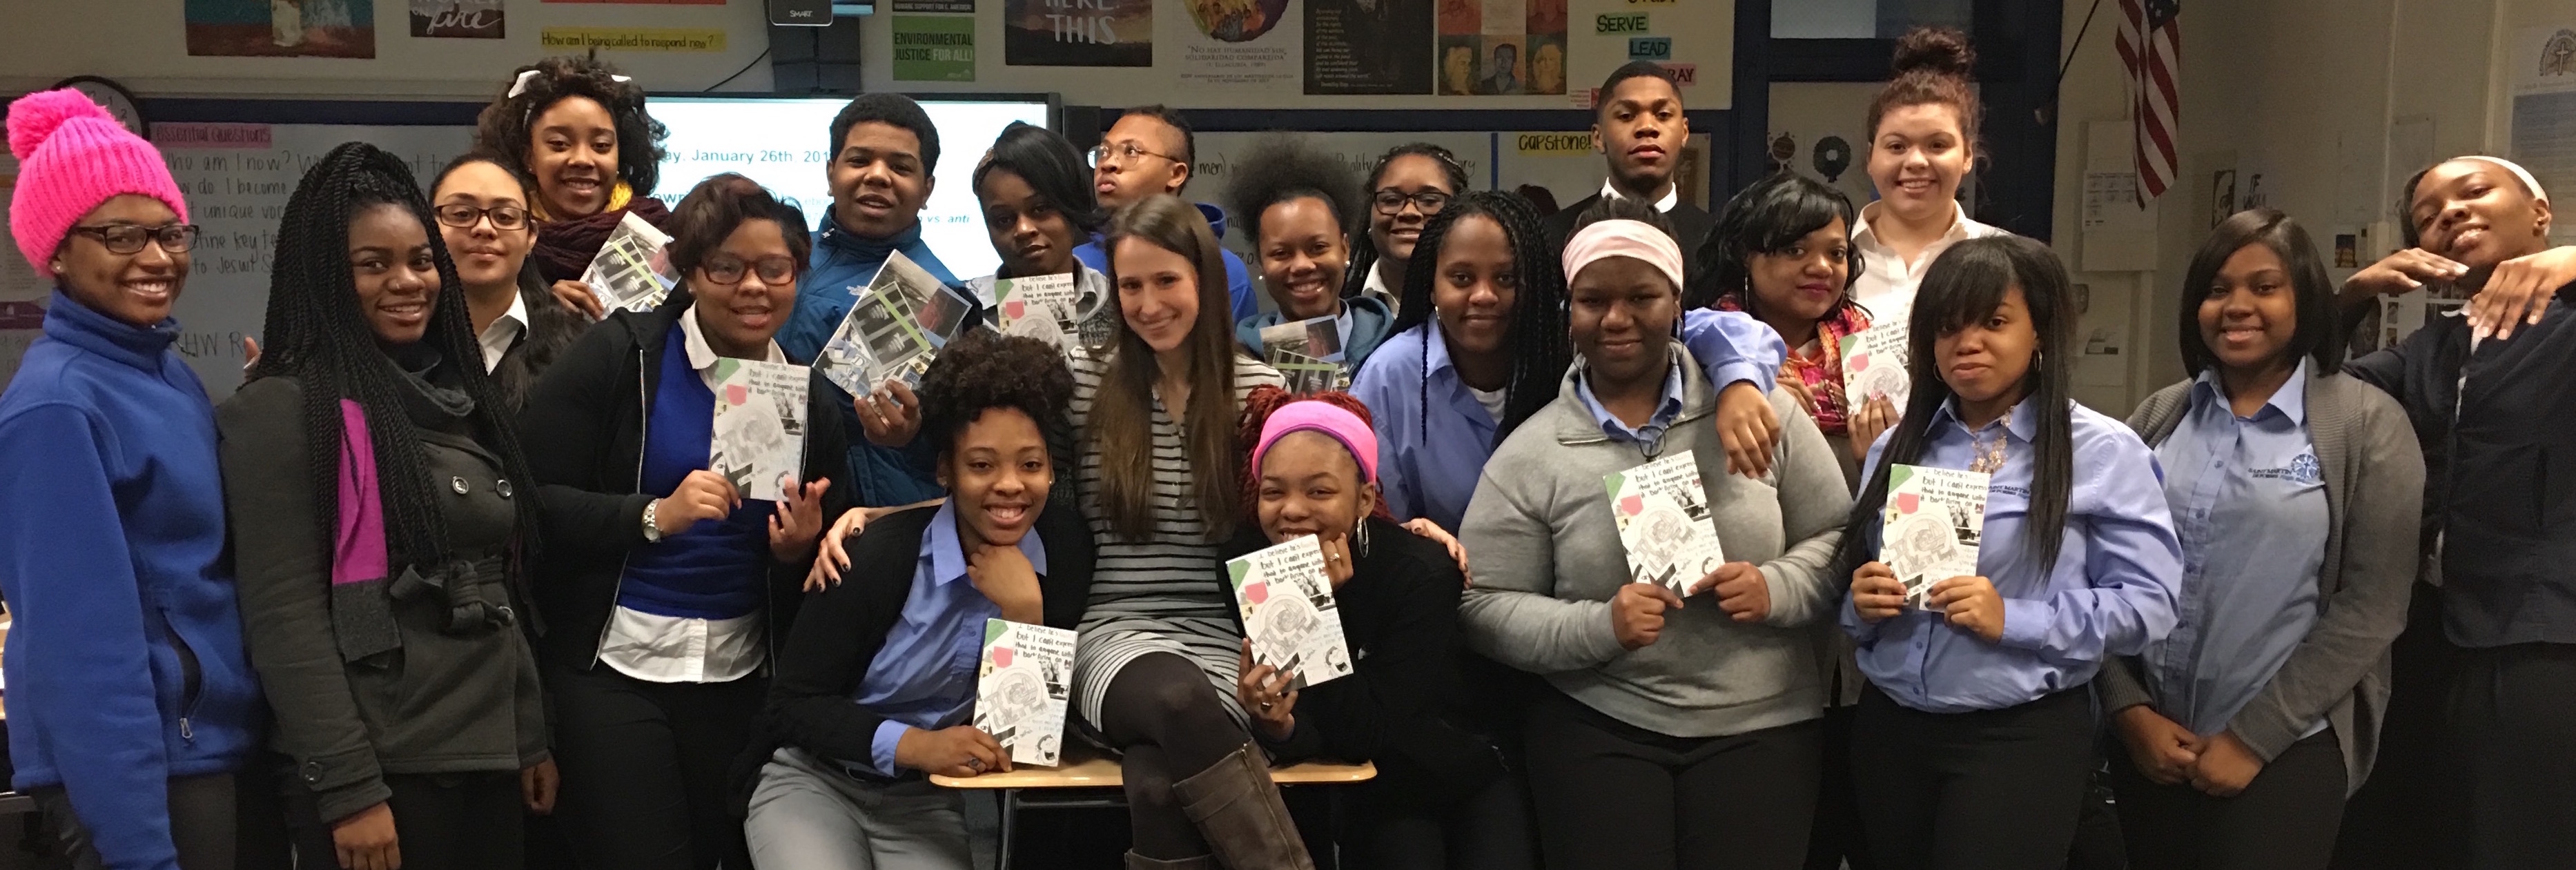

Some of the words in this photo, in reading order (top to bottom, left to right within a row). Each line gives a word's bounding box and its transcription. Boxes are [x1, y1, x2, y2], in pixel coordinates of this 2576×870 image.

[427, 6, 501, 34] fire
[790, 10, 813, 18] SMART
[1597, 14, 1647, 32] SERVE
[541, 32, 564, 46] How
[566, 37, 580, 46] am
[581, 33, 585, 46] I
[587, 33, 611, 50] being
[612, 34, 638, 47] called
[639, 34, 650, 46] to
[651, 35, 686, 50] respond
[689, 35, 714, 49] now?
[894, 32, 973, 46] ENVIRONMENTAL
[895, 49, 930, 61] JUSTICE
[933, 49, 950, 61] FOR
[1629, 40, 1668, 56] LEAD
[1667, 68, 1695, 83] RAY
[120, 108, 128, 119] 2
[203, 155, 228, 172] am
[236, 152, 240, 172] I
[246, 150, 291, 171] now?
[692, 150, 754, 165] January
[803, 150, 829, 163] 201
[197, 177, 215, 195] do
[226, 177, 231, 195] I
[237, 178, 286, 195] become
[233, 231, 258, 261] key
[193, 257, 207, 275] to
[184, 331, 218, 357] HW
[1922, 476, 1935, 485] but
[1016, 631, 1028, 640] but
